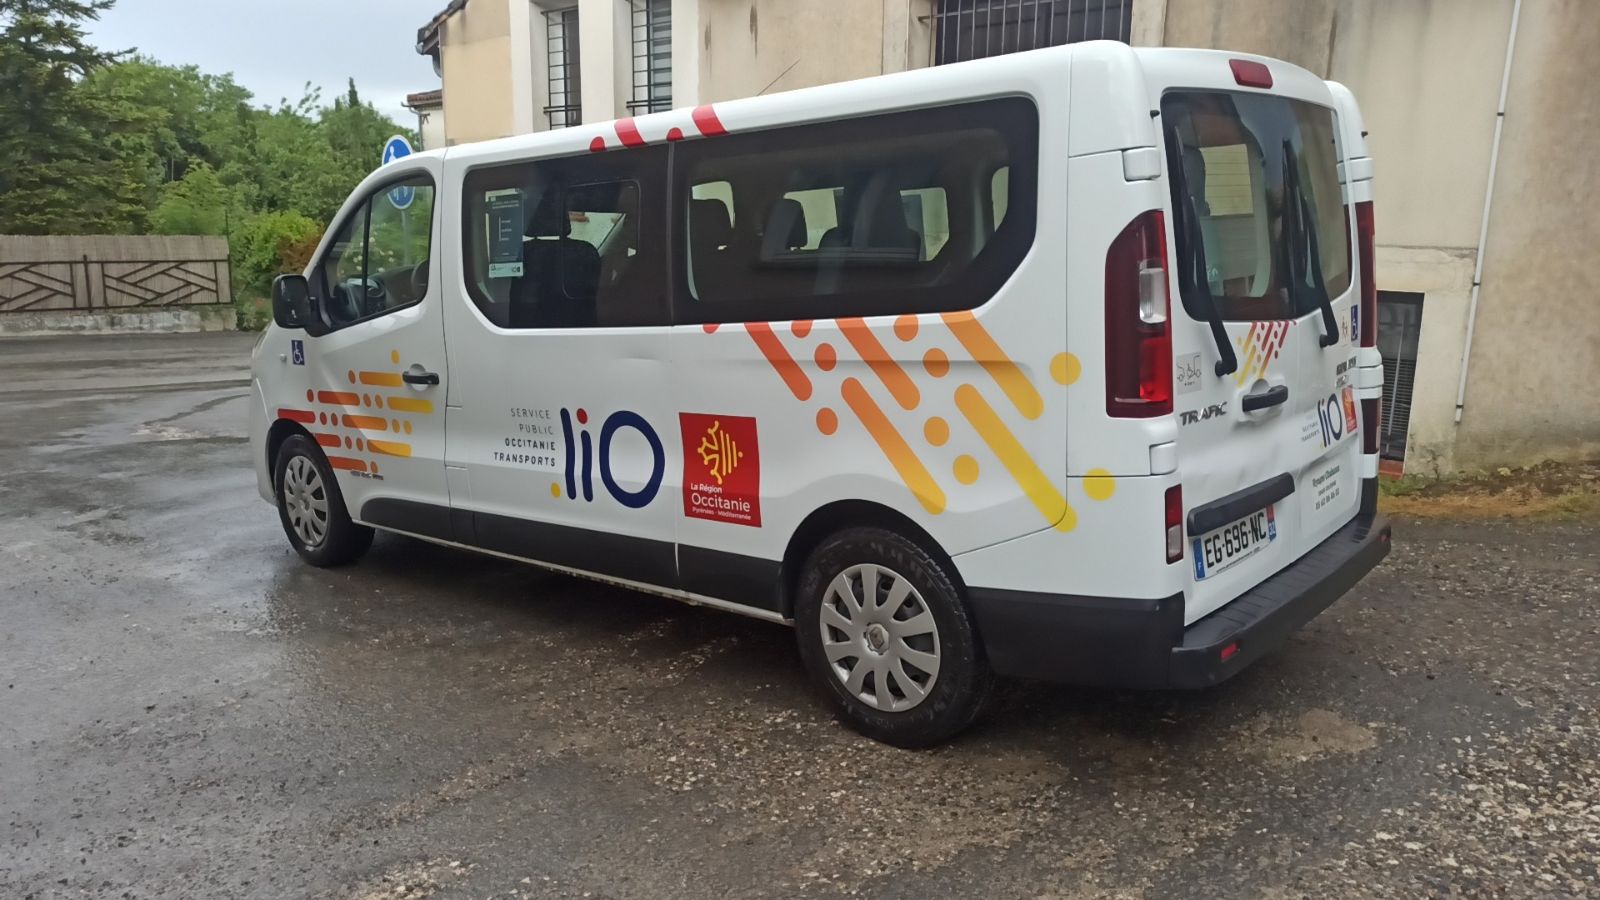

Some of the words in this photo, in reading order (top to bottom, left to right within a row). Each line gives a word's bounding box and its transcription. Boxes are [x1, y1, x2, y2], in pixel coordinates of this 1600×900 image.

[510, 407, 552, 420] SERVICE
[1179, 401, 1228, 426] TRAFIC
[518, 423, 554, 436] PUBLIC
[504, 437, 557, 451] OCCITANIE
[493, 451, 557, 467] TRANSPORTS
[690, 482, 699, 491] La
[699, 483, 723, 494] Région
[691, 492, 751, 513] Occitanie
[1203, 511, 1268, 569] EG-696-NC
